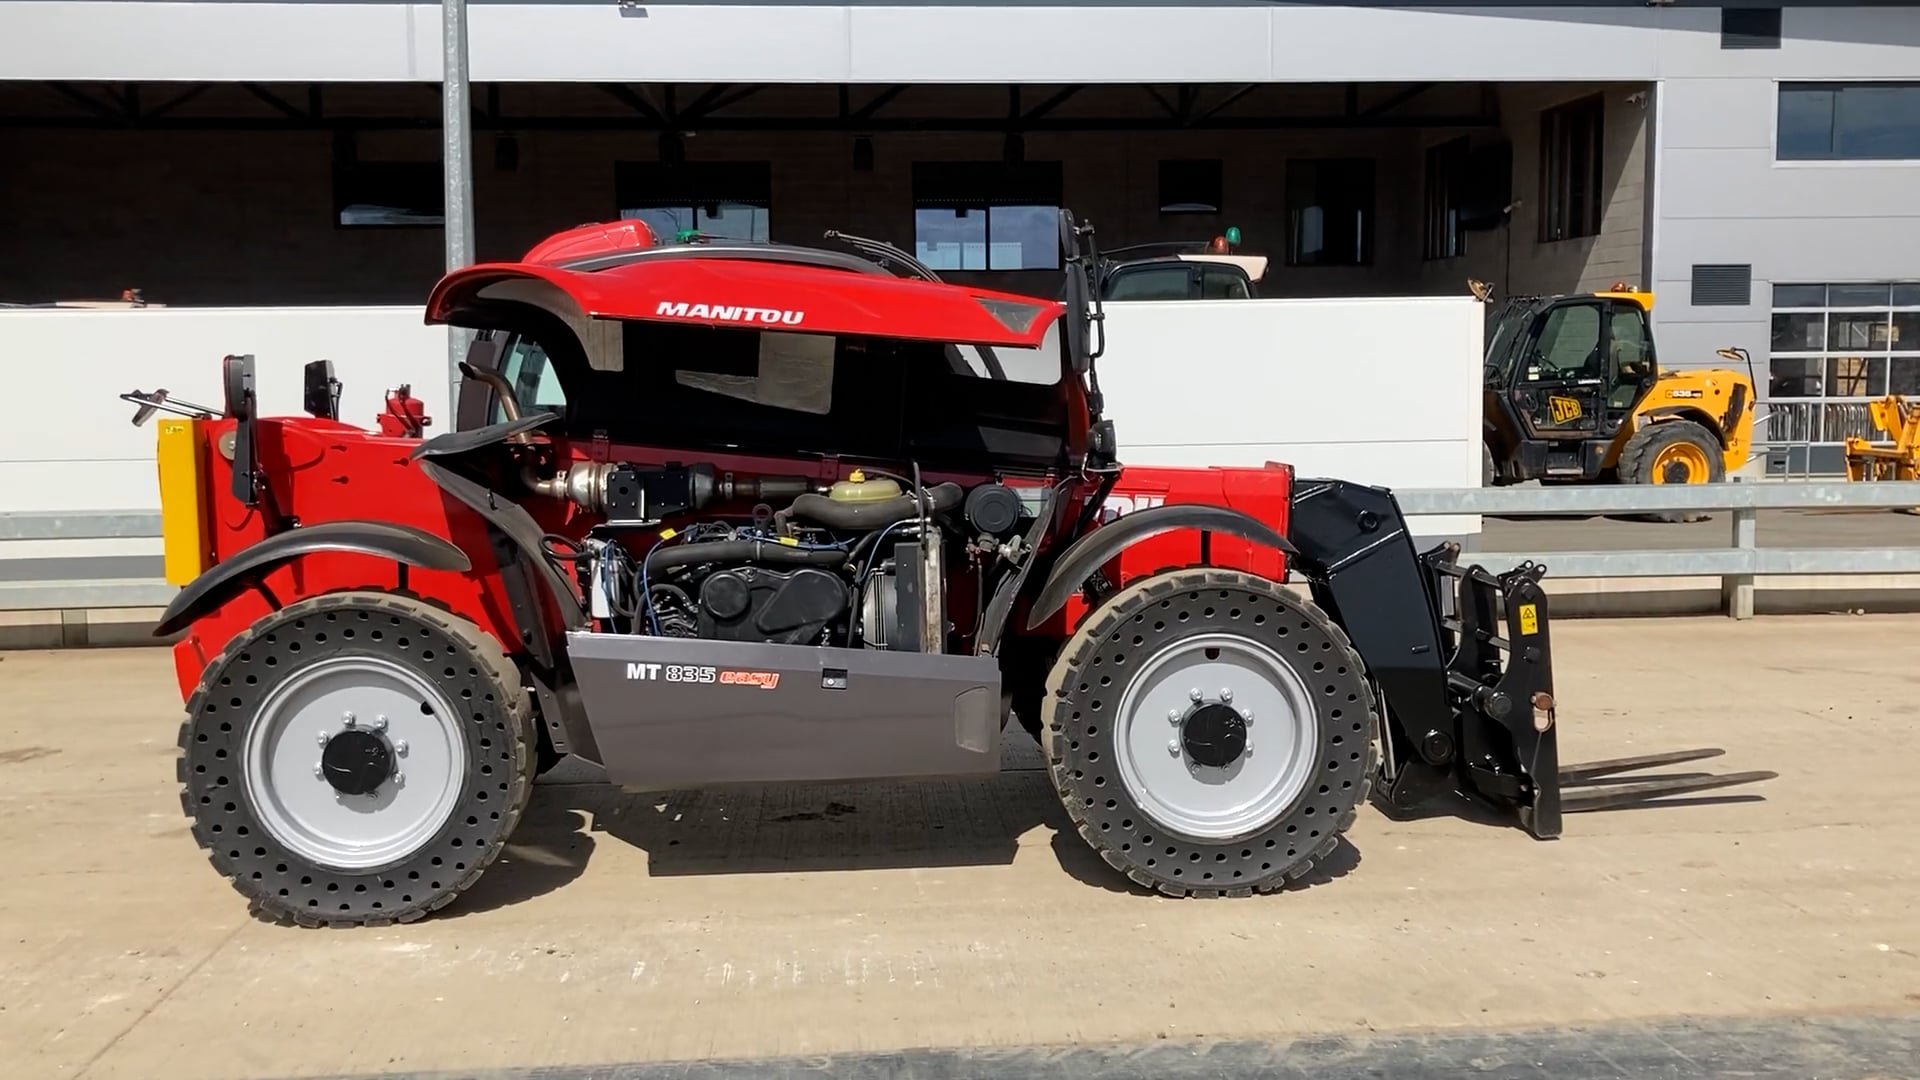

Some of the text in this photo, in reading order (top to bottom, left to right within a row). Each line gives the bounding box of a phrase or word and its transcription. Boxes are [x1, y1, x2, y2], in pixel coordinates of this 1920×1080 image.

[656, 301, 804, 325] MANITOU
[1554, 399, 1580, 421] JCB
[627, 663, 780, 689] MT 835 easy
